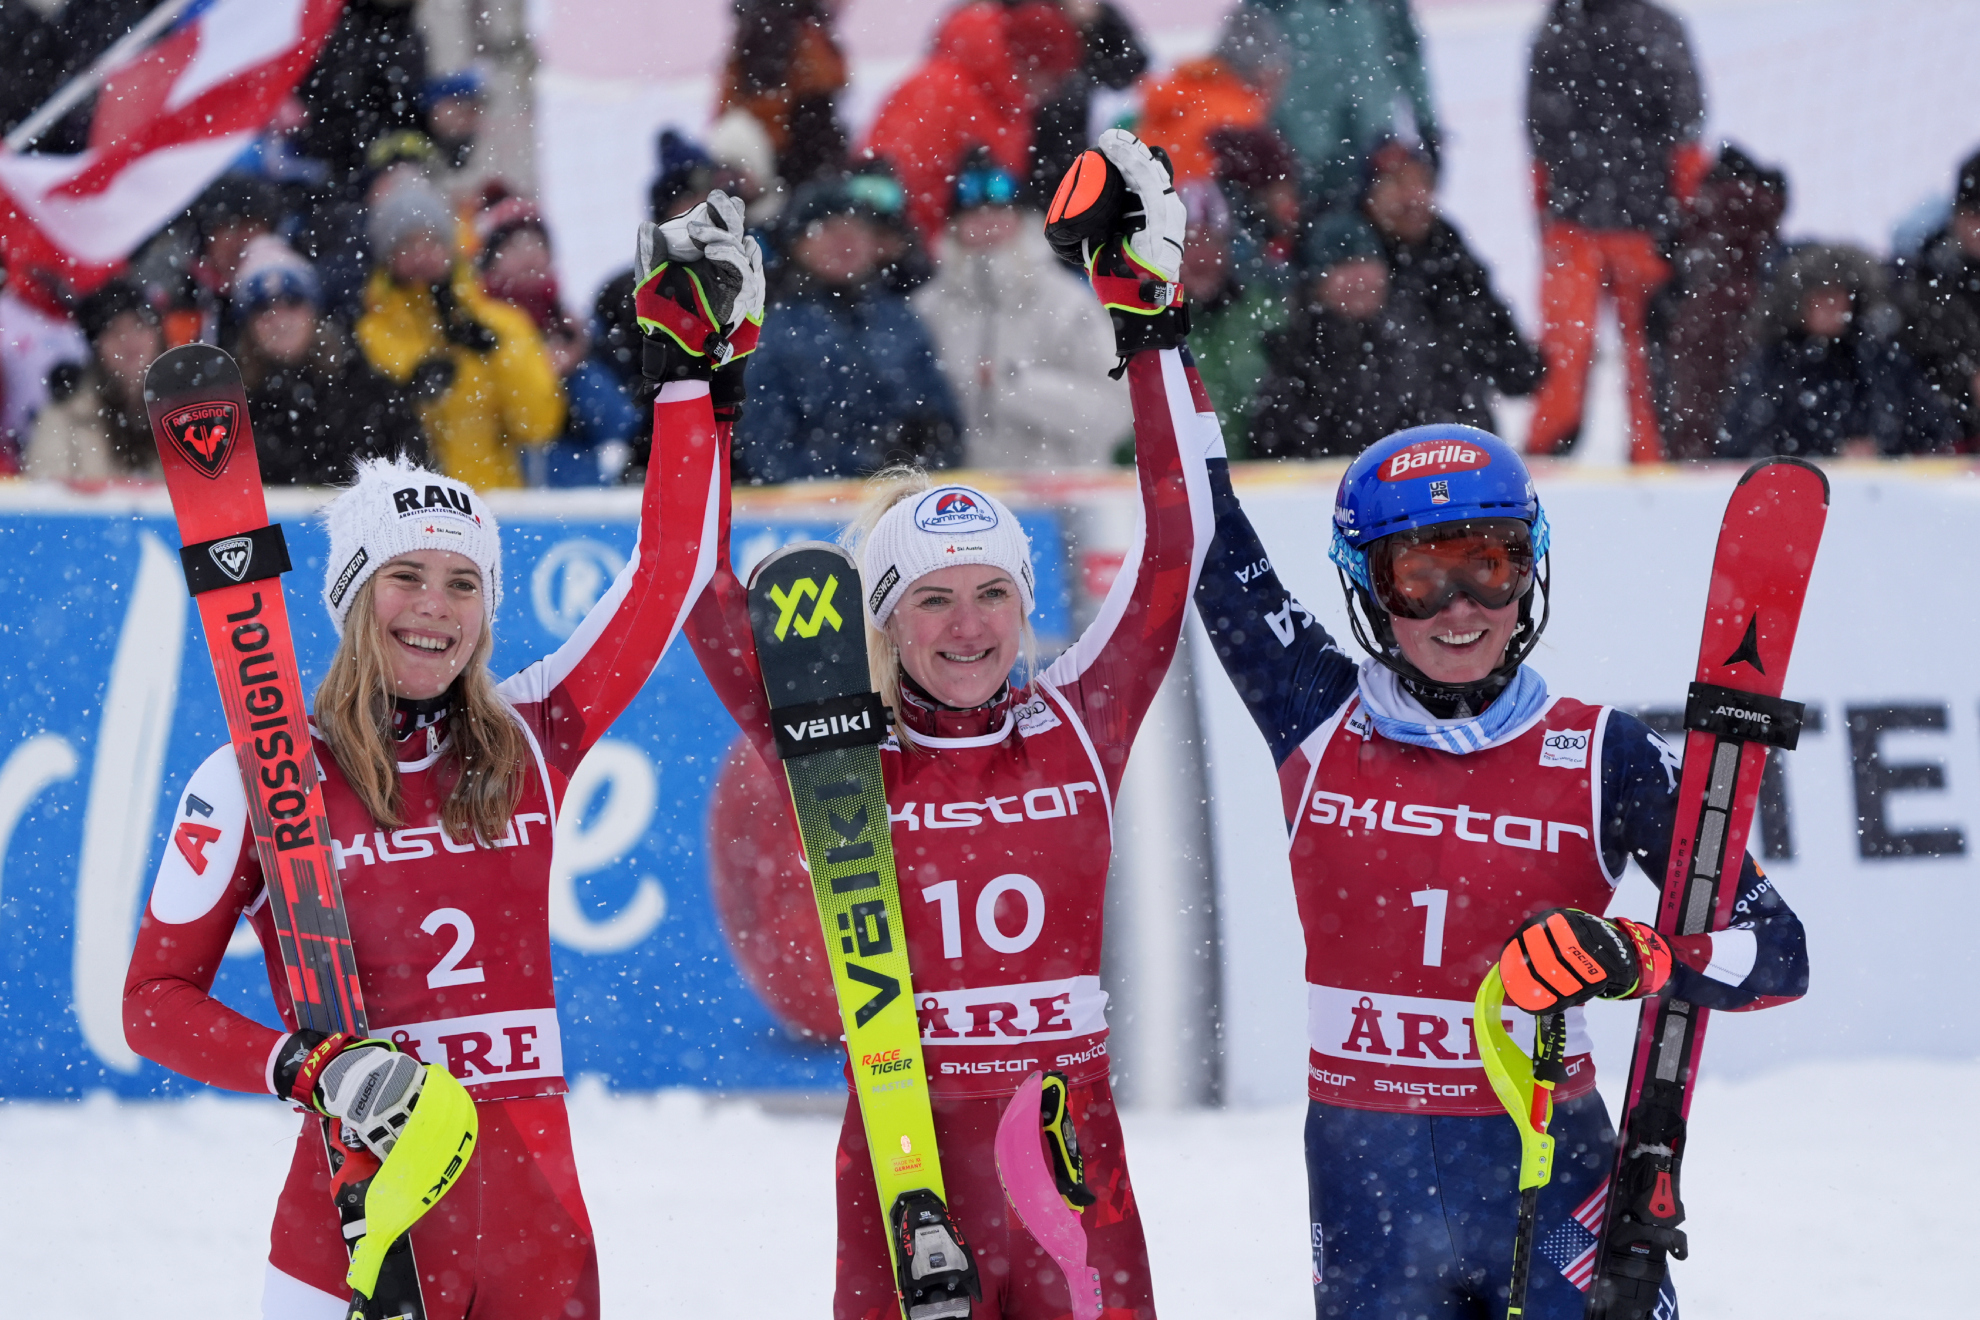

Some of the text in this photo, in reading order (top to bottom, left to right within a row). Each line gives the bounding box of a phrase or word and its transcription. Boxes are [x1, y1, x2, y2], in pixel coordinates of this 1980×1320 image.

[172, 408, 229, 427] ROSSIGNOL
[1390, 445, 1477, 478] Barilla
[392, 485, 473, 516] RAU
[1430, 481, 1447, 491] US
[214, 541, 248, 554] ROSSIGNOL
[331, 551, 366, 604] GIESSWEIN
[870, 569, 898, 611] GIESSWEIN
[227, 591, 316, 852] ROSSIGNOL
[1715, 705, 1772, 724] ATOMIC
[887, 781, 1098, 832] kistar
[331, 812, 548, 870] kistar
[1667, 838, 1688, 910] REDSTER
[921, 873, 1046, 959] 10
[1410, 888, 1449, 968] 1
[419, 907, 486, 990] 2
[1567, 945, 1599, 976] racing
[1624, 921, 1654, 972] LEKI
[918, 991, 1074, 1039] ÅRE
[303, 1032, 343, 1079] LEKI
[862, 1048, 901, 1066] RACE
[870, 1058, 913, 1076] TIGER
[1543, 1032, 1557, 1061] LEKI
[355, 1071, 380, 1117] reusch
[871, 1078, 914, 1094] MASTER
[421, 1131, 474, 1206] LEKI
[894, 1163, 922, 1173] GERMANY
